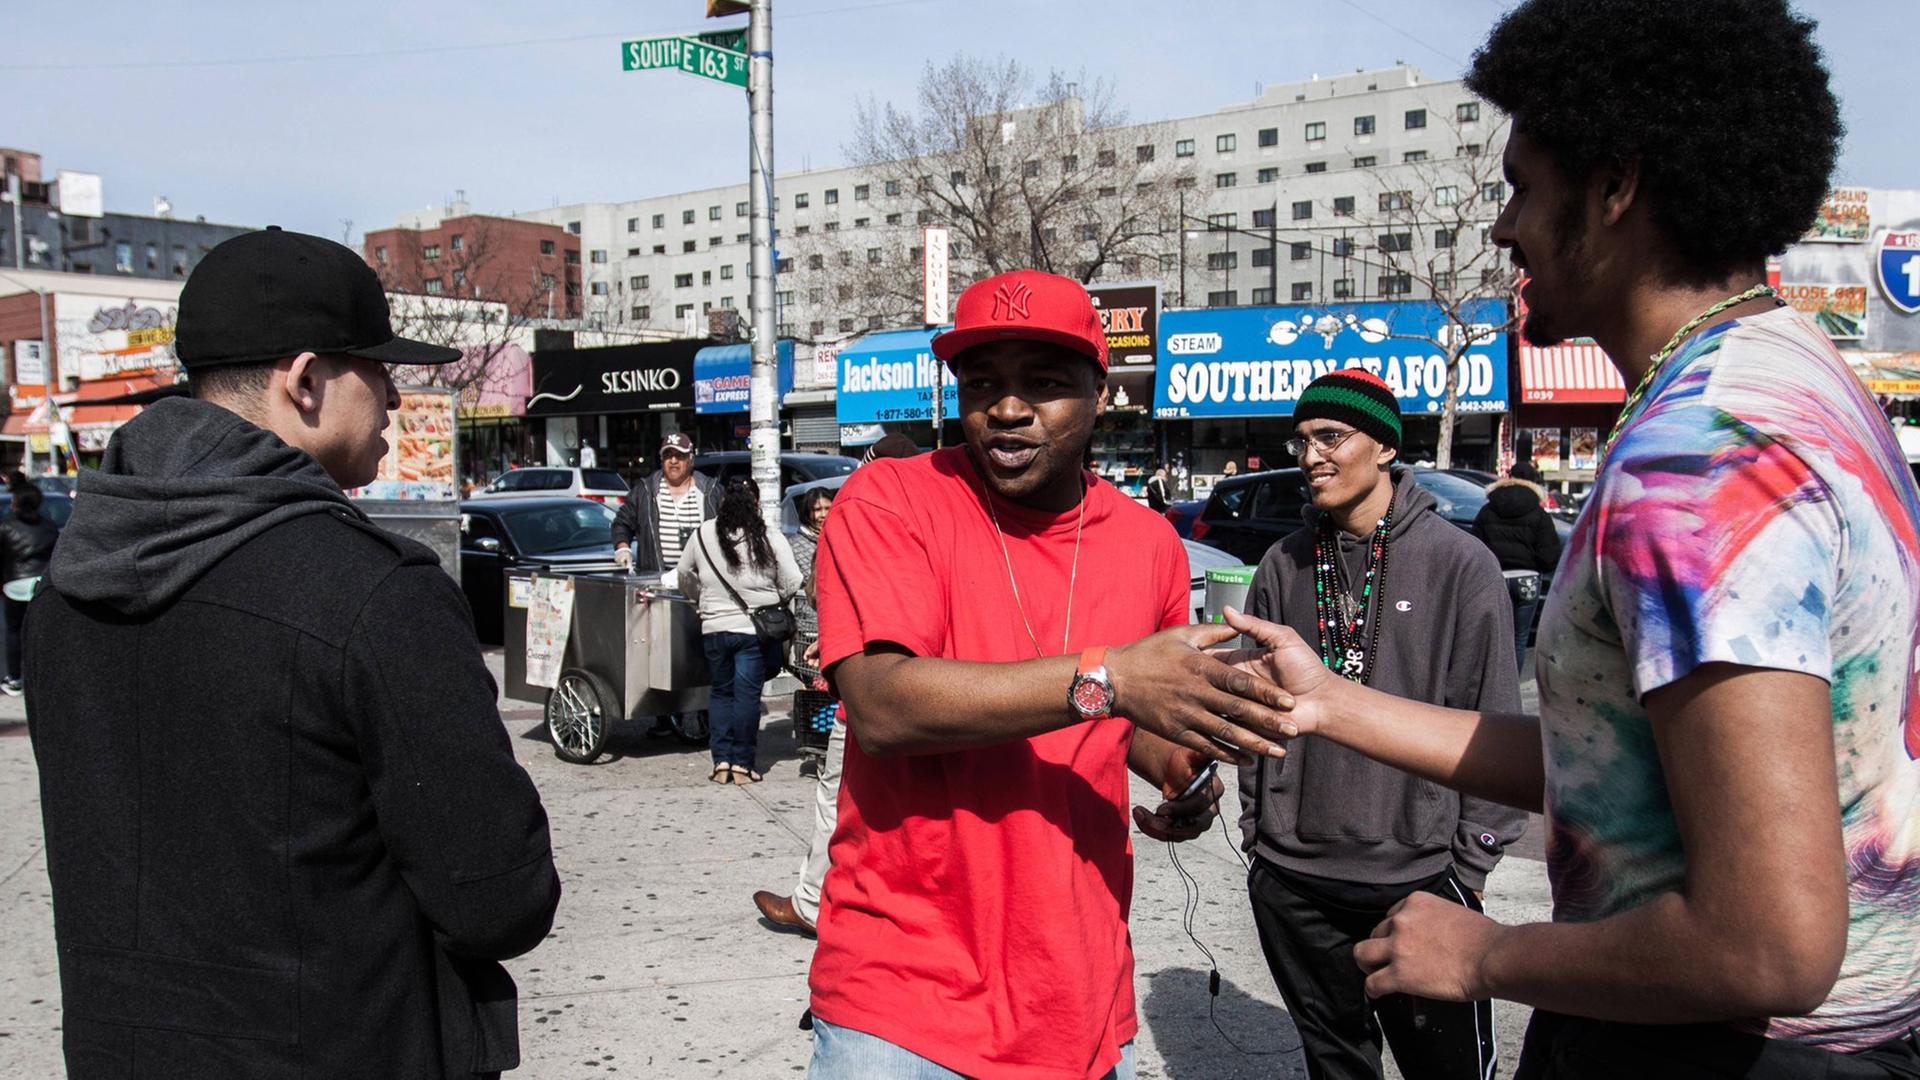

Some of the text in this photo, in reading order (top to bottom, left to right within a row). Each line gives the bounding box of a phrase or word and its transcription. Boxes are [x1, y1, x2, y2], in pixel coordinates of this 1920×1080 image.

[683, 43, 744, 80] E 163 ST
[1099, 306, 1147, 333] ERY
[1106, 335, 1150, 348] CCASIONS
[1172, 337, 1216, 351] STEAM
[817, 349, 843, 362] REN
[601, 367, 681, 394] SESINKO
[842, 356, 914, 393] Jackson
[1344, 353, 1493, 397] AFOOD
[713, 376, 750, 390] GAME
[715, 390, 749, 401] EXPRESS
[1527, 390, 1554, 400] 1039
[1156, 407, 1179, 417] 1037
[1440, 400, 1505, 411] -842-3040
[876, 407, 947, 419] 1-877-580-100
[842, 425, 863, 436] 50%
[1212, 572, 1244, 583] Recycle
